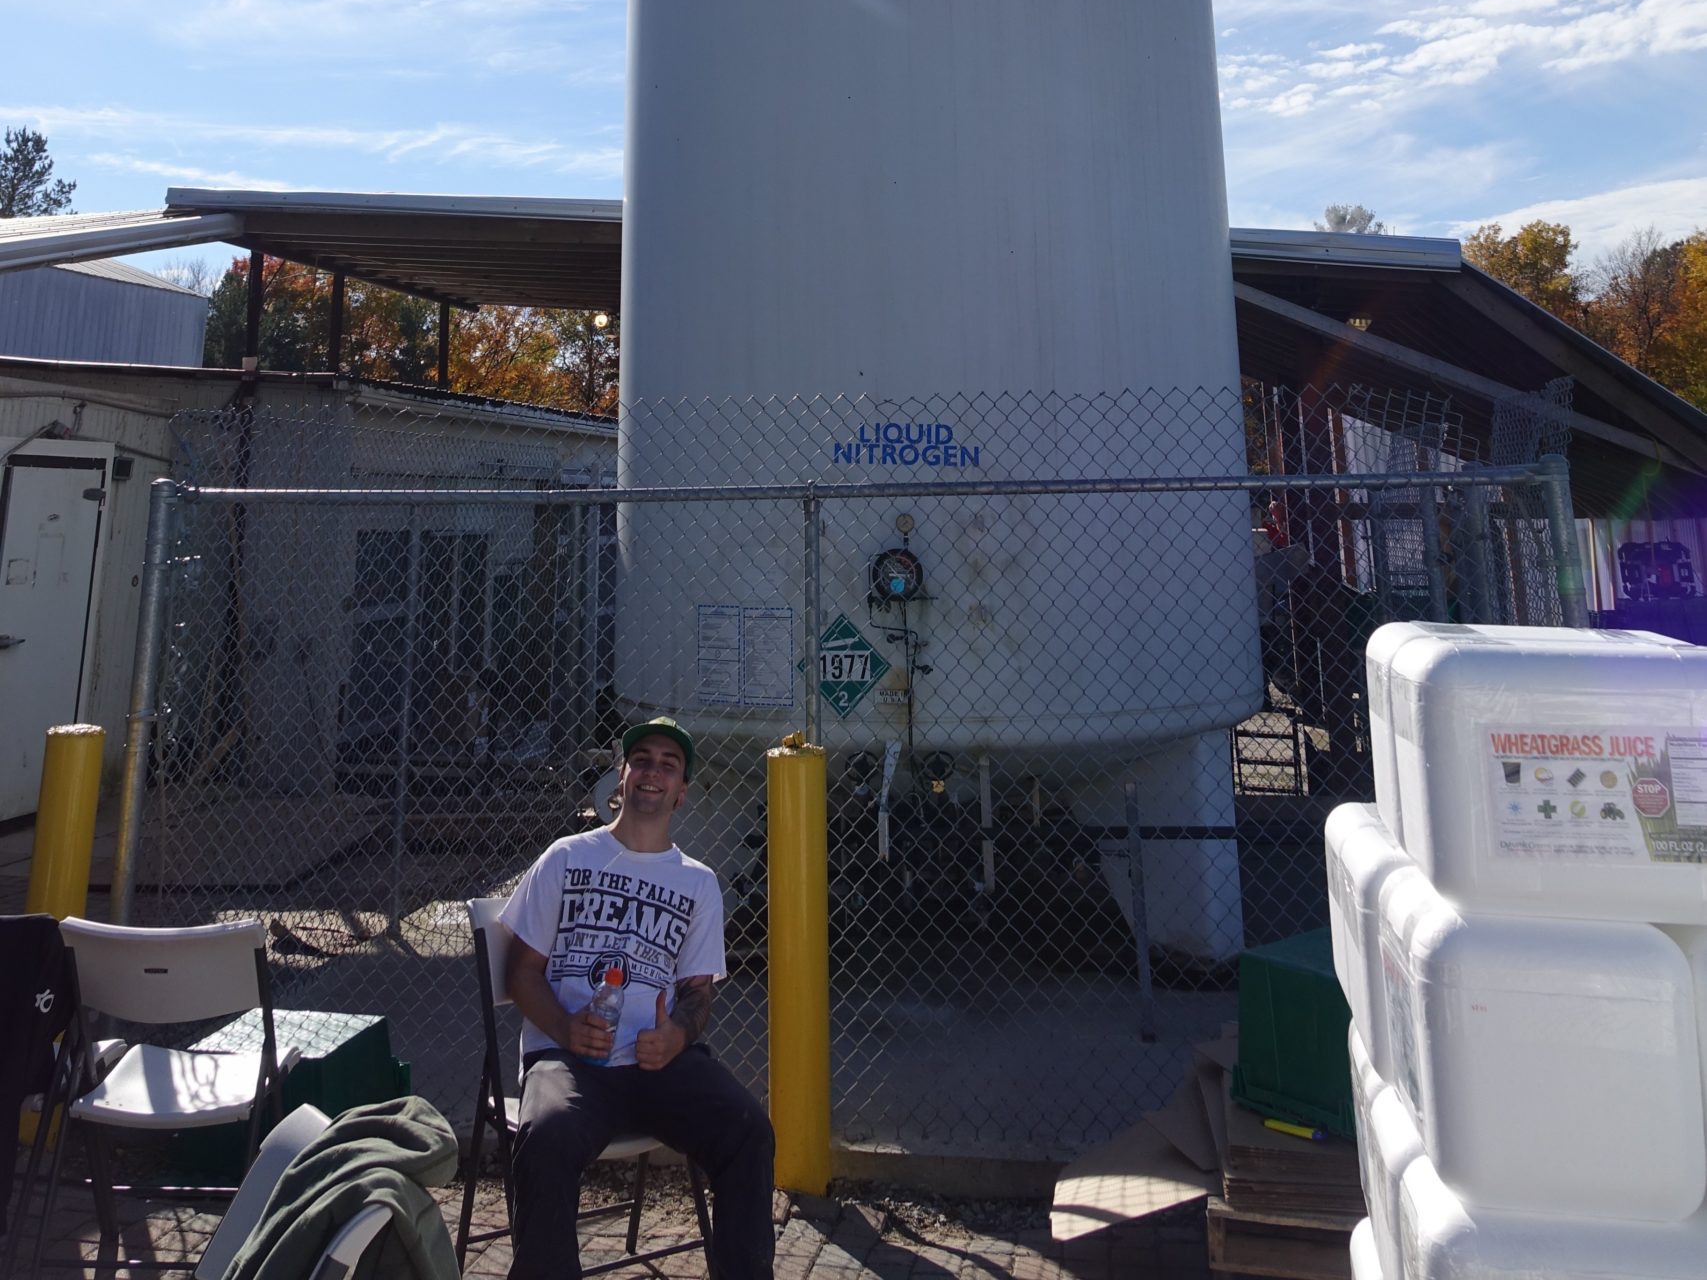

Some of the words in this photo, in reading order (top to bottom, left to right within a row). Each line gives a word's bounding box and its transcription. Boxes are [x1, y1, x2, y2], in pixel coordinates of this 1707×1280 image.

[859, 422, 953, 445] LIQUID
[834, 442, 980, 467] NITROGEN
[820, 654, 869, 680] 1977
[838, 691, 849, 707] 2
[1491, 733, 1604, 757] WHEATGRASS
[1608, 735, 1656, 758] JUICE
[1637, 783, 1661, 794] STOP
[565, 868, 592, 887] FOR
[598, 870, 632, 894] THE
[635, 879, 697, 916] FALLEN
[560, 892, 689, 955] DREAMS
[602, 934, 631, 950] LET
[633, 940, 663, 964] THIS
